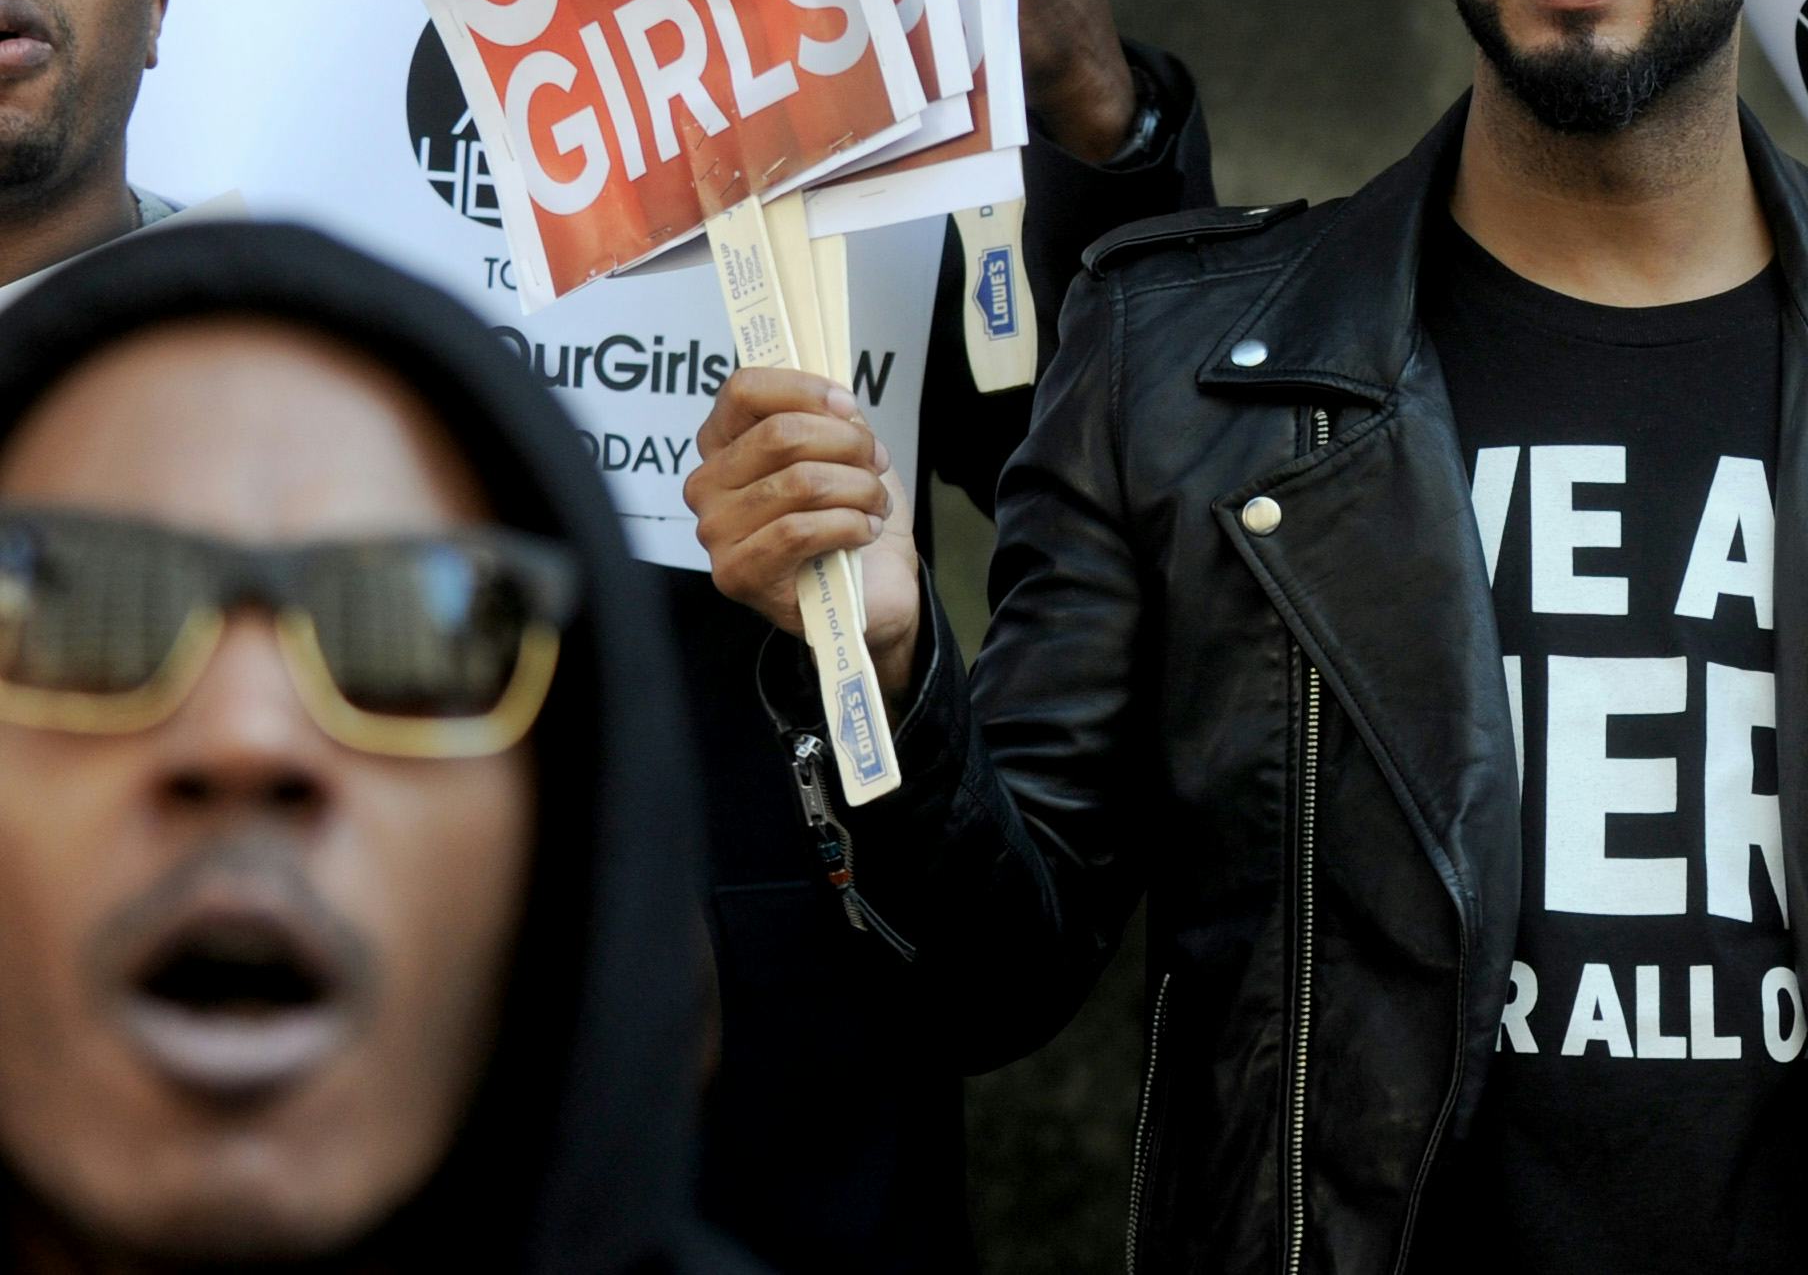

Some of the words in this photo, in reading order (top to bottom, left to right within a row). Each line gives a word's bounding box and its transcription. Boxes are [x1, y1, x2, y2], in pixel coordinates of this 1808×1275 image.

[825, 606, 846, 642] you
[836, 646, 849, 672] Do
[1559, 962, 1742, 1060] ALL
